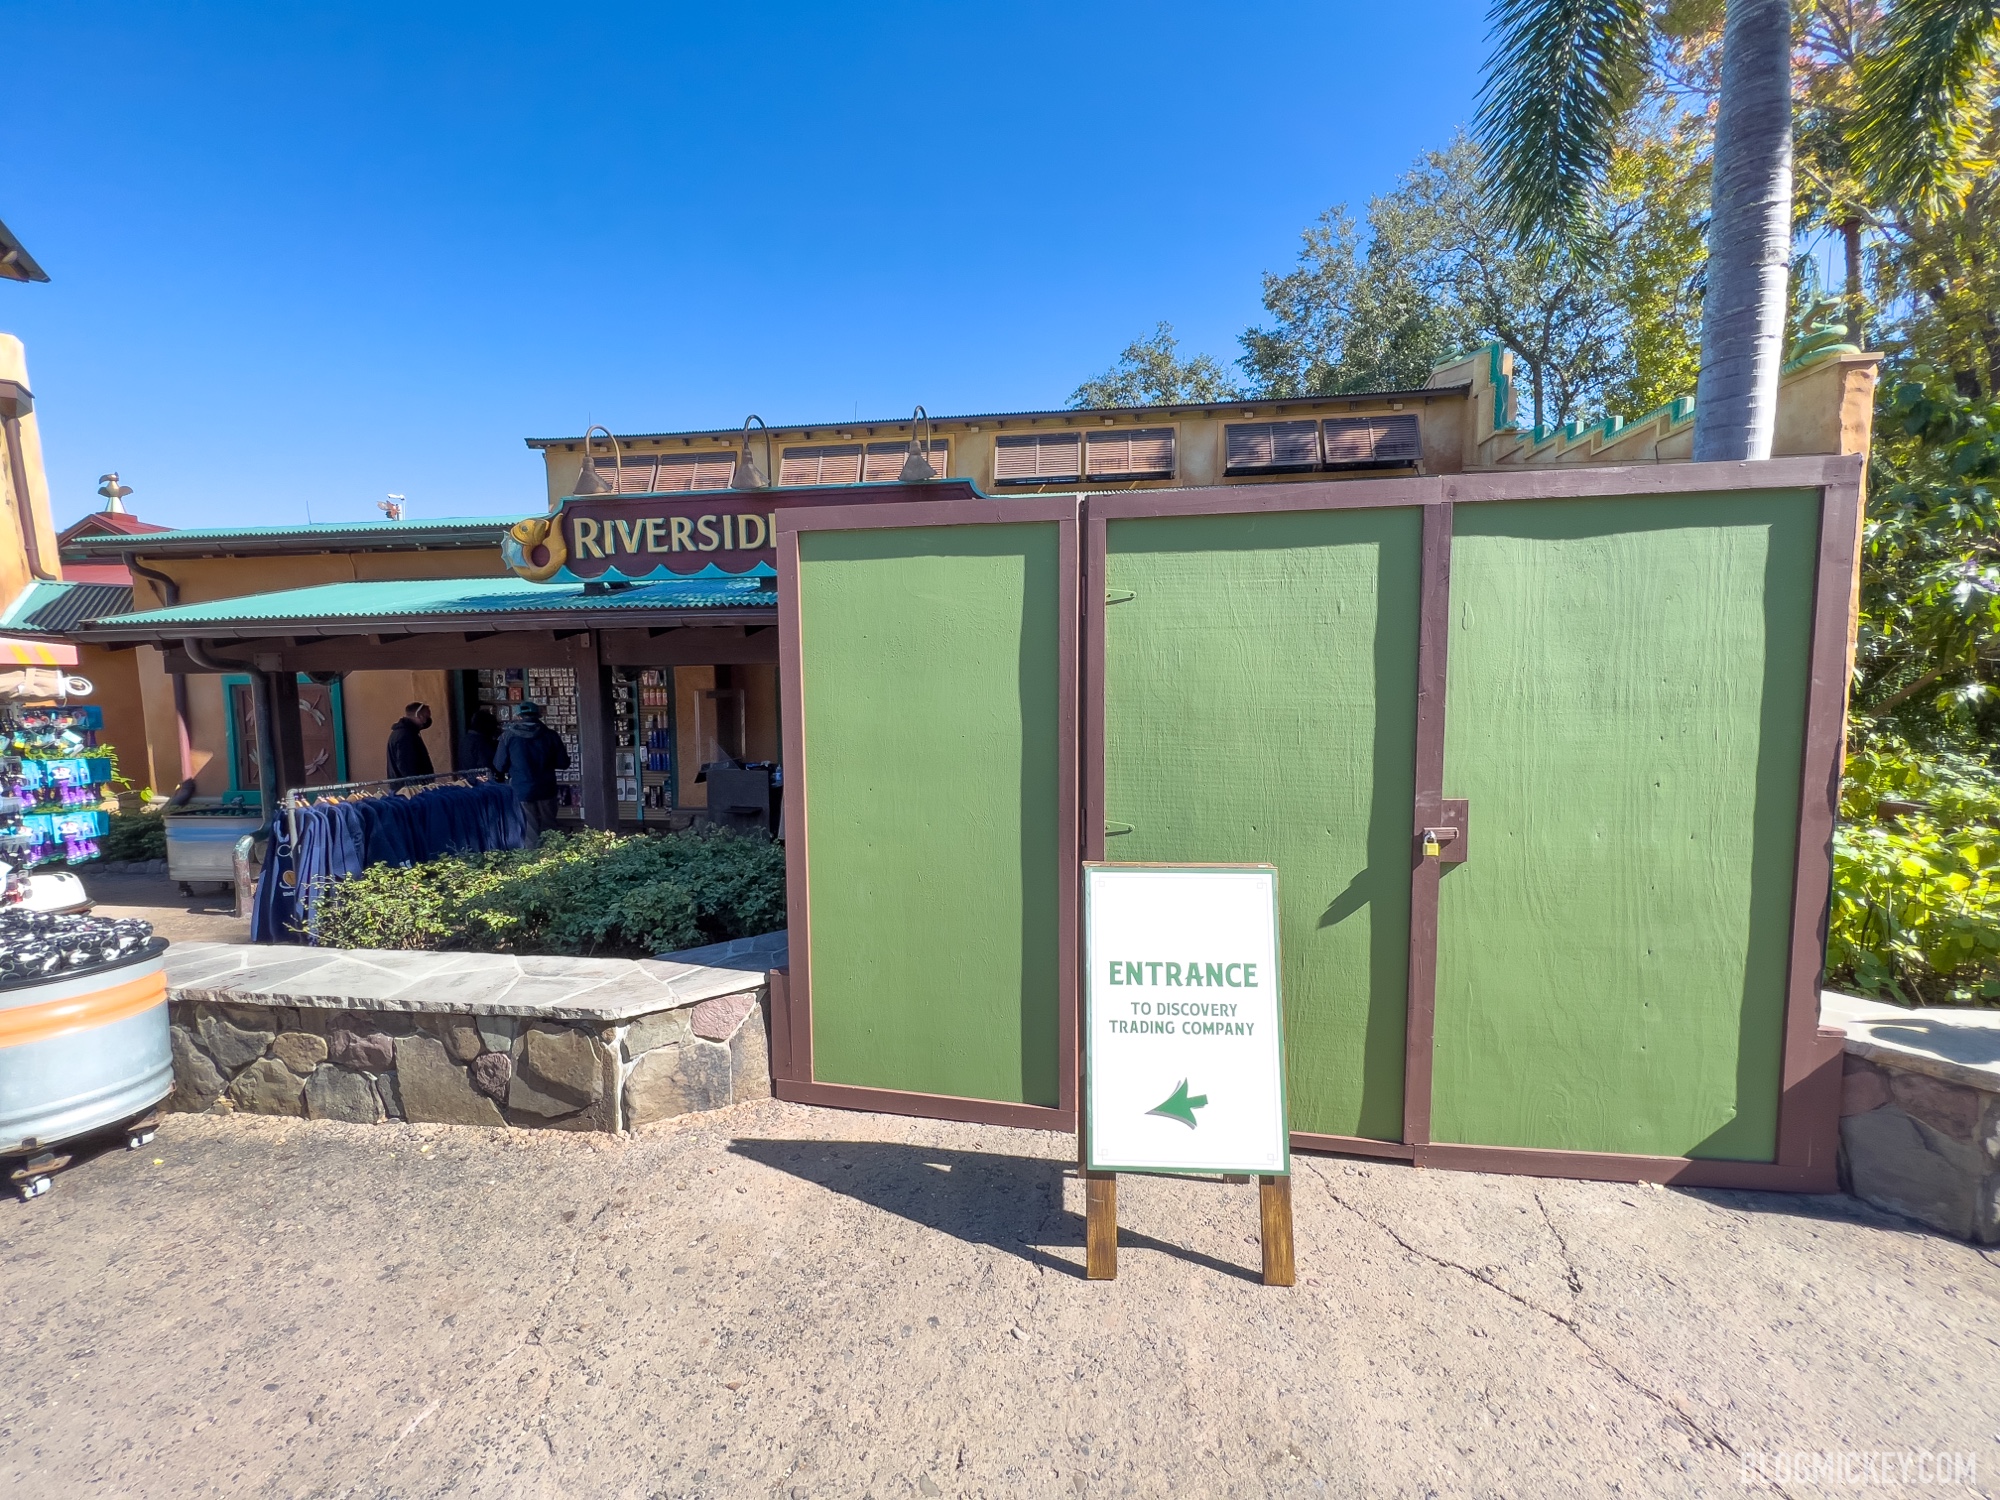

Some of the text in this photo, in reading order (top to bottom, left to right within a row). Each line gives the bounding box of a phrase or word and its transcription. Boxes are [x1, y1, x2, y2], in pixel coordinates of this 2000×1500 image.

[572, 513, 777, 560] RIVERSID
[1109, 960, 1259, 988] ENTRANCE
[1130, 1001, 1238, 1017] TO DISCOVERY
[1109, 1019, 1255, 1036] TRADING COMPANY
